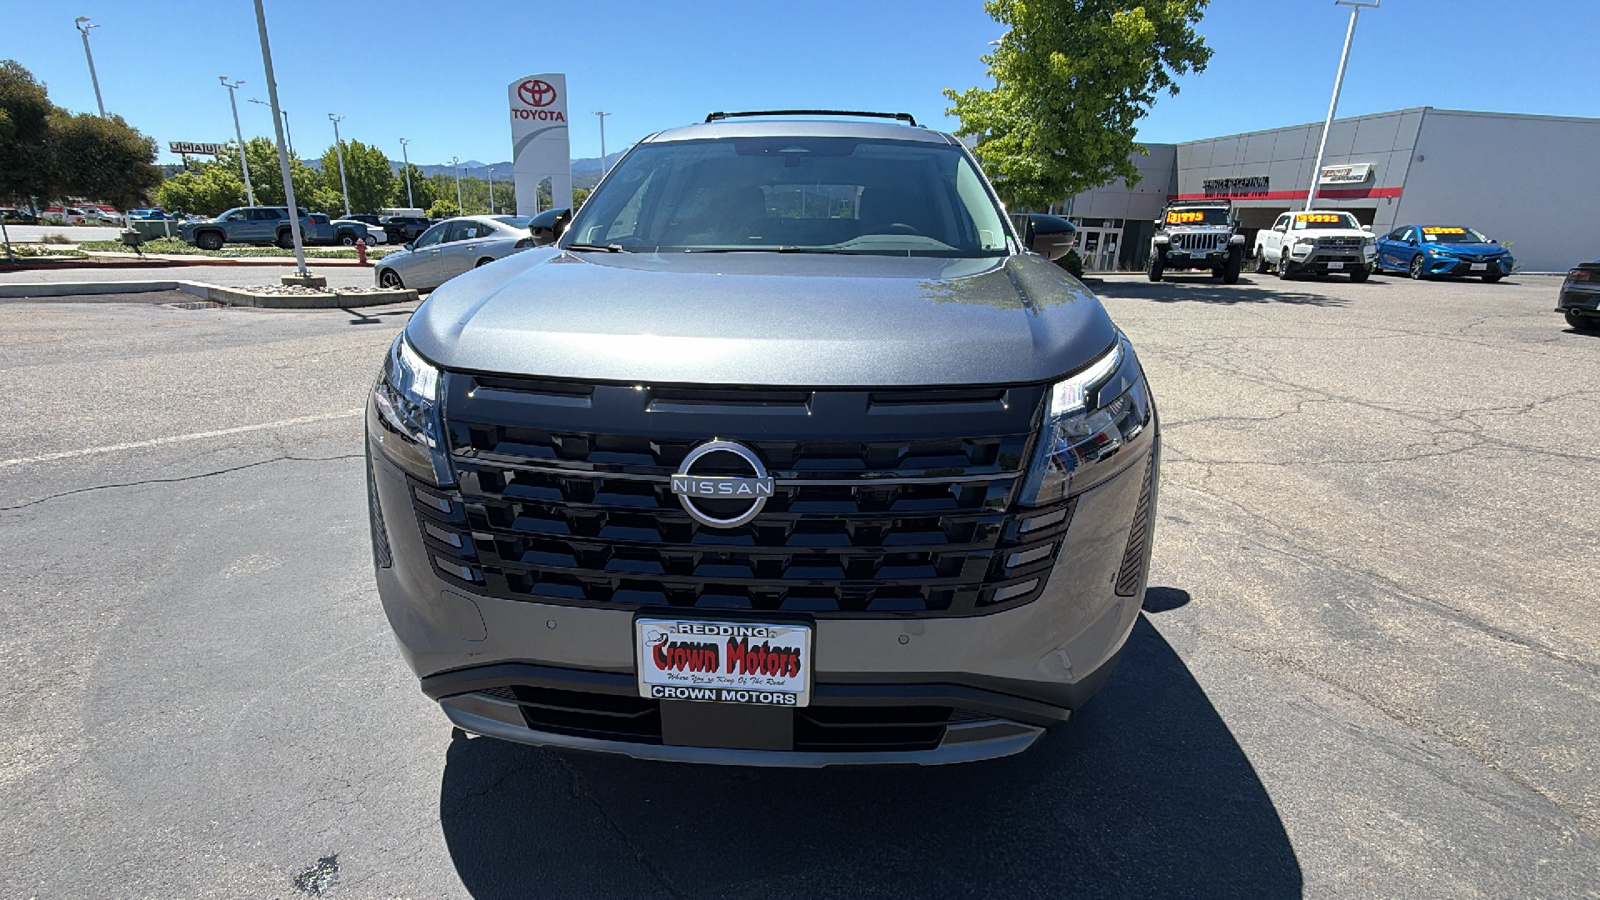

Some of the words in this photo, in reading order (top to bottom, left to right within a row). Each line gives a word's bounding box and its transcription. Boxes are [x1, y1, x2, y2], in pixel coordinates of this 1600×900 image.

[511, 108, 566, 122] TOYOTA
[673, 479, 771, 494] NISSAN
[678, 624, 768, 638] REDDING
[652, 635, 719, 674] Crown
[726, 637, 801, 678] Motors
[667, 672, 689, 681] Where
[716, 675, 735, 685] King
[738, 676, 748, 685] Of
[750, 676, 764, 685] The
[765, 677, 786, 686] Road
[652, 686, 717, 701] CROWN
[721, 690, 796, 705] MOTORS
